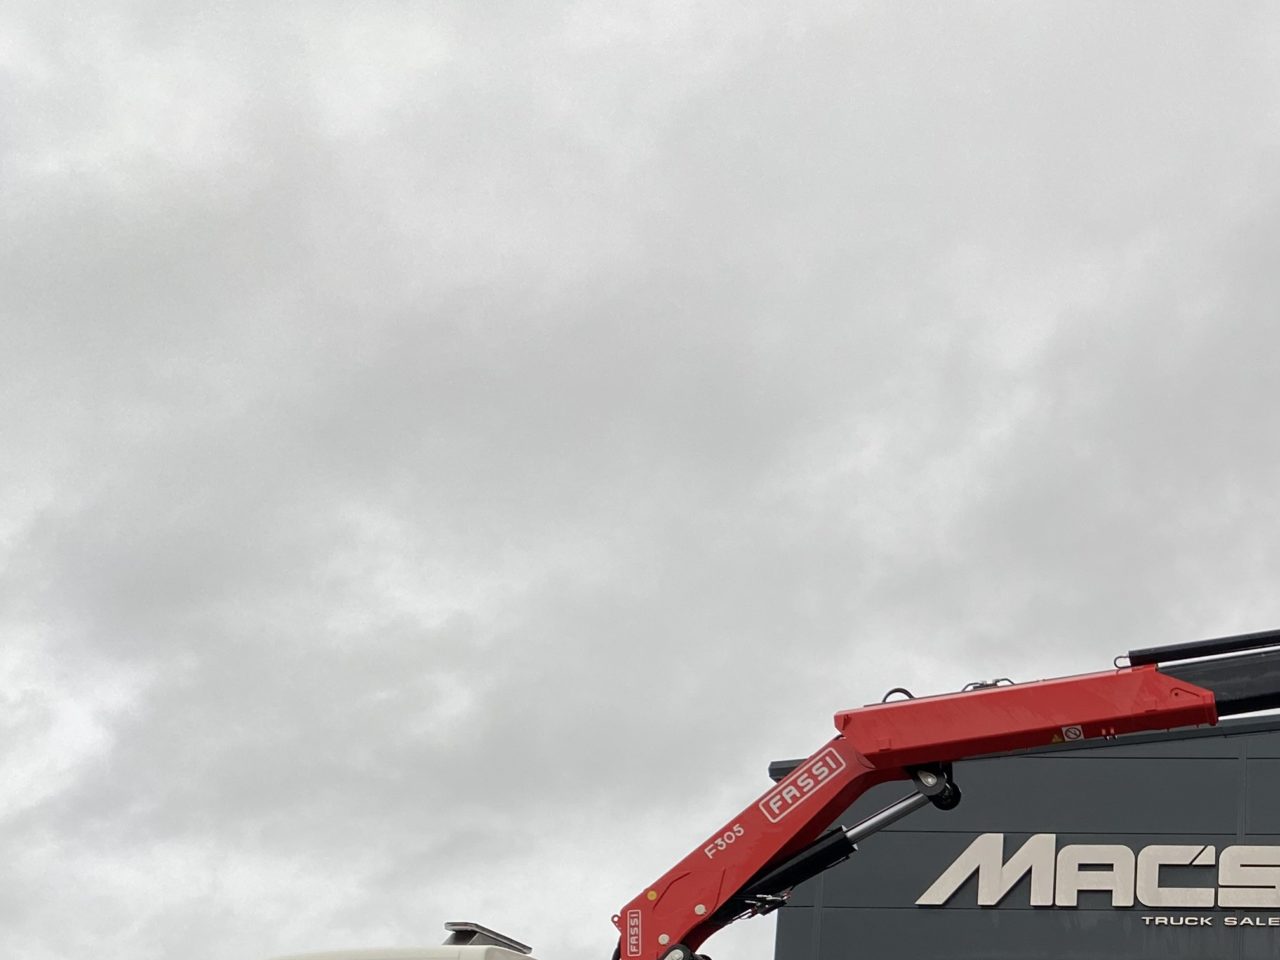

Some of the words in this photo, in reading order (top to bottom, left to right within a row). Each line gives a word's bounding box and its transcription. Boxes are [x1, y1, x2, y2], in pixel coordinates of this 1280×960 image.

[768, 755, 837, 815] FASSI
[704, 823, 745, 859] F305
[630, 913, 640, 953] FASSI
[1142, 916, 1212, 927] TRUCK
